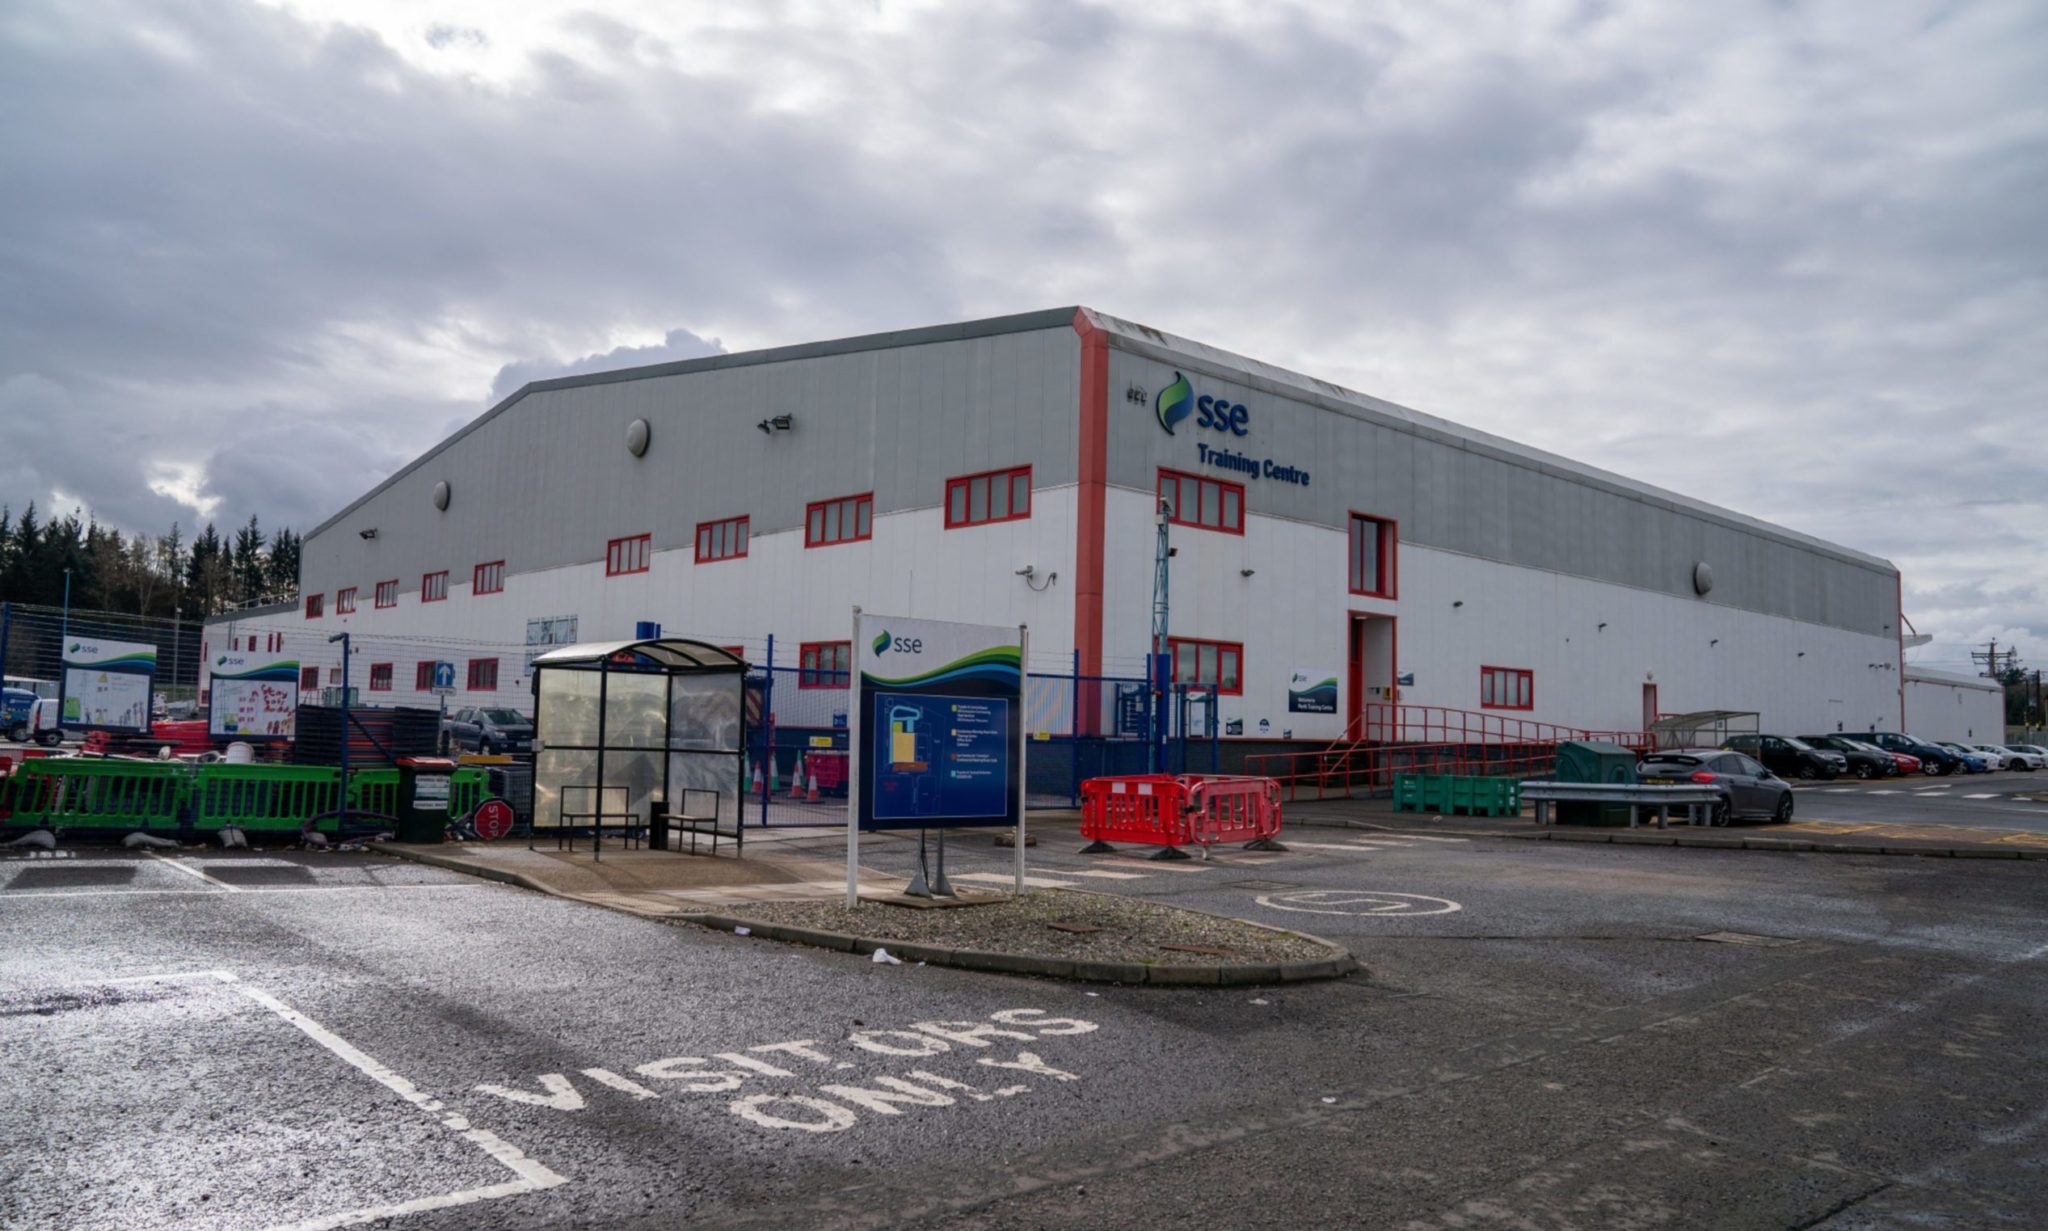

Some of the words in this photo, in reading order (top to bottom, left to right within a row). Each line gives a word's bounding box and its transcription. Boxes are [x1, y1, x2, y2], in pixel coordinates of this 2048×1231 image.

[1197, 394, 1250, 436] sse
[1198, 443, 1260, 480] Training
[1263, 459, 1311, 487] Centre
[81, 645, 98, 654] sse
[227, 657, 245, 666] sse
[893, 635, 923, 655] sse
[488, 805, 500, 837] STOP
[475, 1008, 1100, 1112] VISITORS
[730, 1051, 1080, 1134] ONLY
